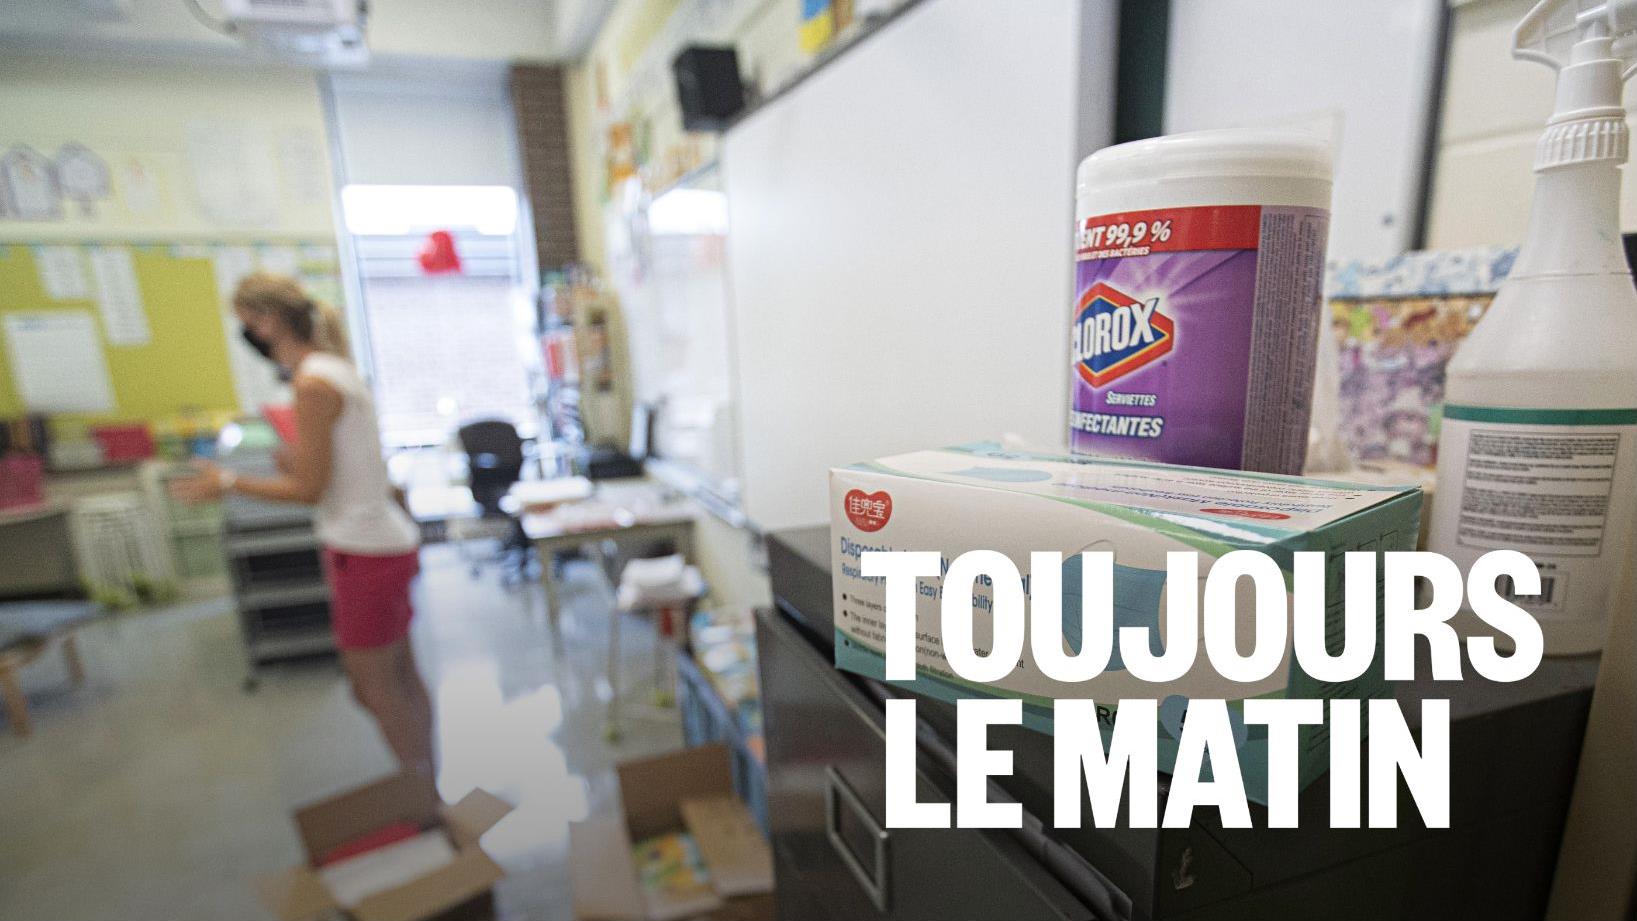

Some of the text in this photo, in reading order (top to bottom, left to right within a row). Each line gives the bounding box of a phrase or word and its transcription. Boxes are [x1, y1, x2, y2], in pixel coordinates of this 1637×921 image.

[1106, 221, 1147, 248] 99,9
[1151, 219, 1172, 243] %
[920, 581, 937, 600] Easy
